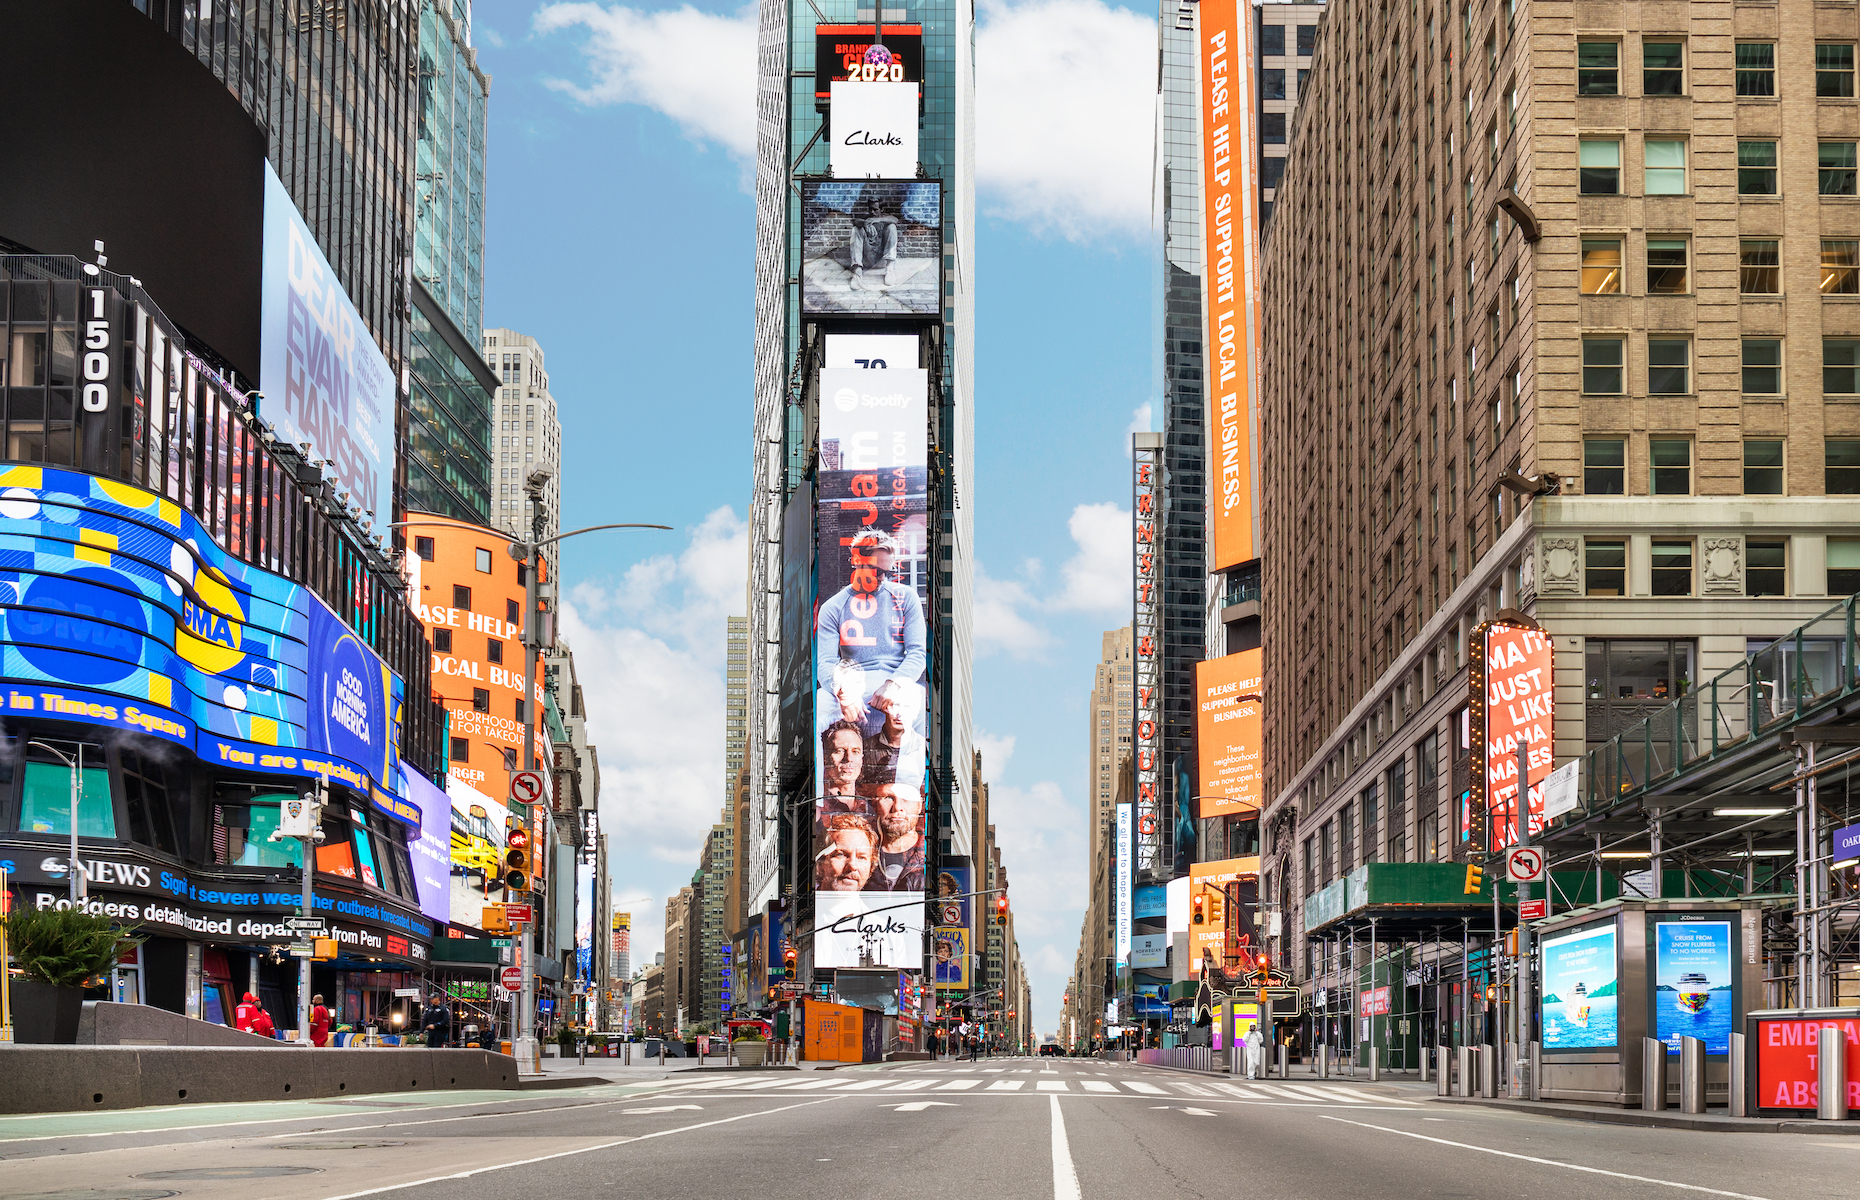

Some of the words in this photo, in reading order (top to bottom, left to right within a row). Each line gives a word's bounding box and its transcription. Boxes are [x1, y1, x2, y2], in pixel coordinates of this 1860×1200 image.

[835, 44, 872, 54] BRAND
[848, 63, 904, 82] 2020
[1210, 29, 1229, 124] PLEASE
[844, 129, 902, 146] Clarks
[1213, 124, 1231, 187] HELP
[1215, 193, 1235, 304] SUPPORT
[288, 216, 356, 379] DEAR
[83, 289, 110, 413] 1500
[287, 282, 350, 430] EVAN
[1218, 310, 1236, 390] LOCAL
[355, 397, 372, 428] BEST
[861, 393, 909, 409] Spotify
[285, 347, 378, 526] HANSEN
[355, 416, 381, 464] MUSICAL
[892, 431, 907, 509] GIGATON
[1220, 391, 1241, 518] BUSINESS.
[840, 431, 879, 527] Jam
[1137, 464, 1154, 604] ERNST
[839, 537, 879, 647] Pearl
[184, 591, 237, 649] GMA
[468, 611, 517, 641] HELP
[891, 615, 905, 648] THE
[1488, 641, 1526, 675] MA
[342, 667, 362, 698] GOOD
[1207, 682, 1238, 697] PLEASE
[1239, 676, 1261, 691] HELP
[1488, 667, 1542, 707] JUST
[10, 691, 34, 710] in
[40, 693, 118, 720] Times
[123, 706, 187, 740] Square
[336, 680, 367, 720] MORNING
[1201, 695, 1240, 712] SUPPORT
[1213, 706, 1257, 723] BUSINESS.
[331, 696, 371, 746] AMERICA
[457, 720, 481, 735] FOR
[484, 725, 525, 746] TAKEOUT
[1226, 745, 1245, 754] These
[1488, 723, 1548, 759] MAMA
[218, 743, 255, 765] You
[259, 752, 298, 769] are
[301, 758, 362, 789] watching
[1137, 687, 1156, 836] YOUNG
[1213, 751, 1259, 767] neighborhood
[1218, 763, 1254, 776] restaurants
[1488, 746, 1553, 785] MAES
[1208, 779, 1220, 787] are
[1221, 776, 1235, 785] now
[1236, 774, 1254, 785] open
[1225, 784, 1249, 795] takeout
[1120, 810, 1128, 825] We
[1215, 797, 1229, 807] and
[585, 812, 597, 851] Locker
[1120, 827, 1128, 839] all
[1118, 841, 1127, 856] get
[1120, 859, 1127, 868] to
[67, 857, 151, 888] NEWS
[1118, 870, 1127, 898] shape
[1217, 872, 1238, 883] CHRIS
[198, 888, 260, 906] severe
[262, 891, 335, 911] weaher
[337, 899, 380, 920] outbreak
[144, 903, 184, 928] details
[331, 925, 358, 945] from
[360, 929, 382, 949] Peru
[832, 913, 906, 934] Clarks
[1673, 934, 1694, 942] CRUISE
[1695, 934, 1713, 942] FROM
[387, 934, 409, 957] ESPN
[1748, 916, 1757, 964] Newsstand
[942, 991, 964, 999] hulu
